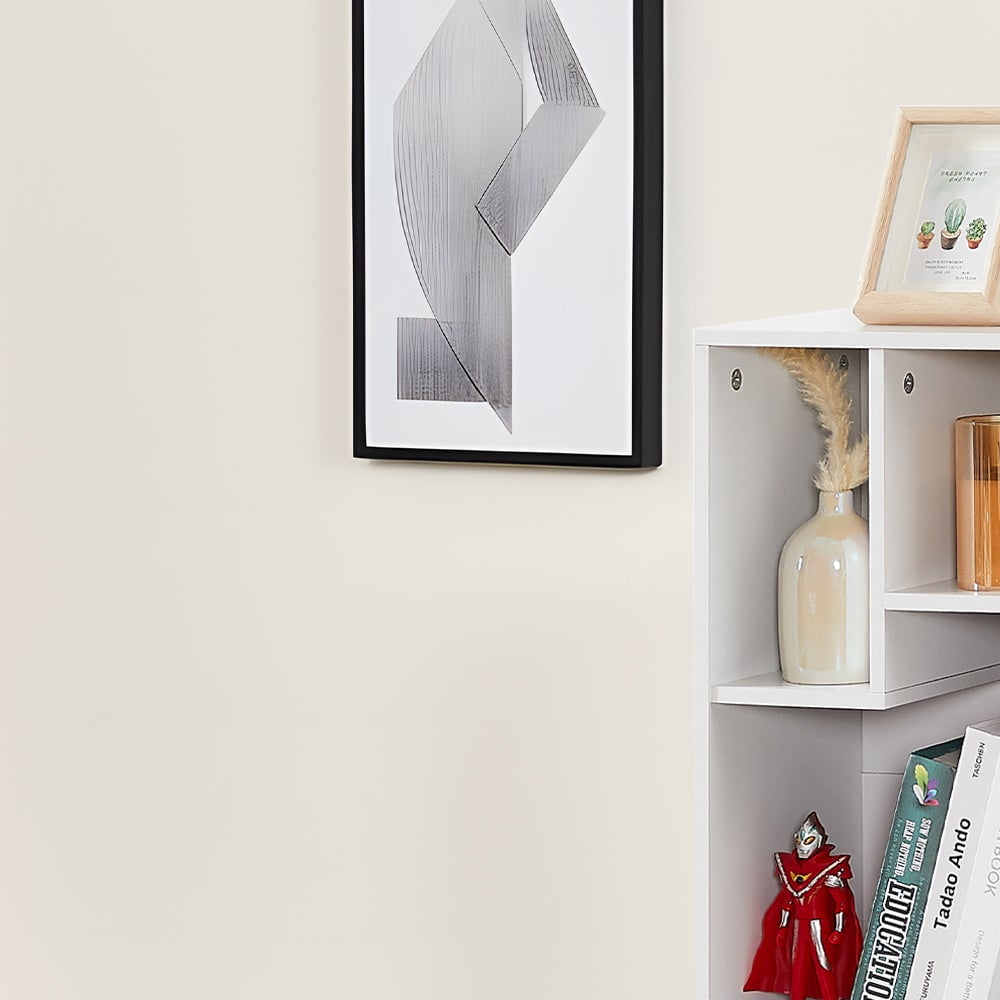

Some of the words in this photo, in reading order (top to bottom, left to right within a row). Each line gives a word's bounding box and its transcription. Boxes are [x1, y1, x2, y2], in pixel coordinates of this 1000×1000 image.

[972, 742, 985, 778] TASCHEN
[919, 818, 932, 836] SOW
[934, 873, 958, 929] Tadao
[949, 818, 971, 869] Ando
